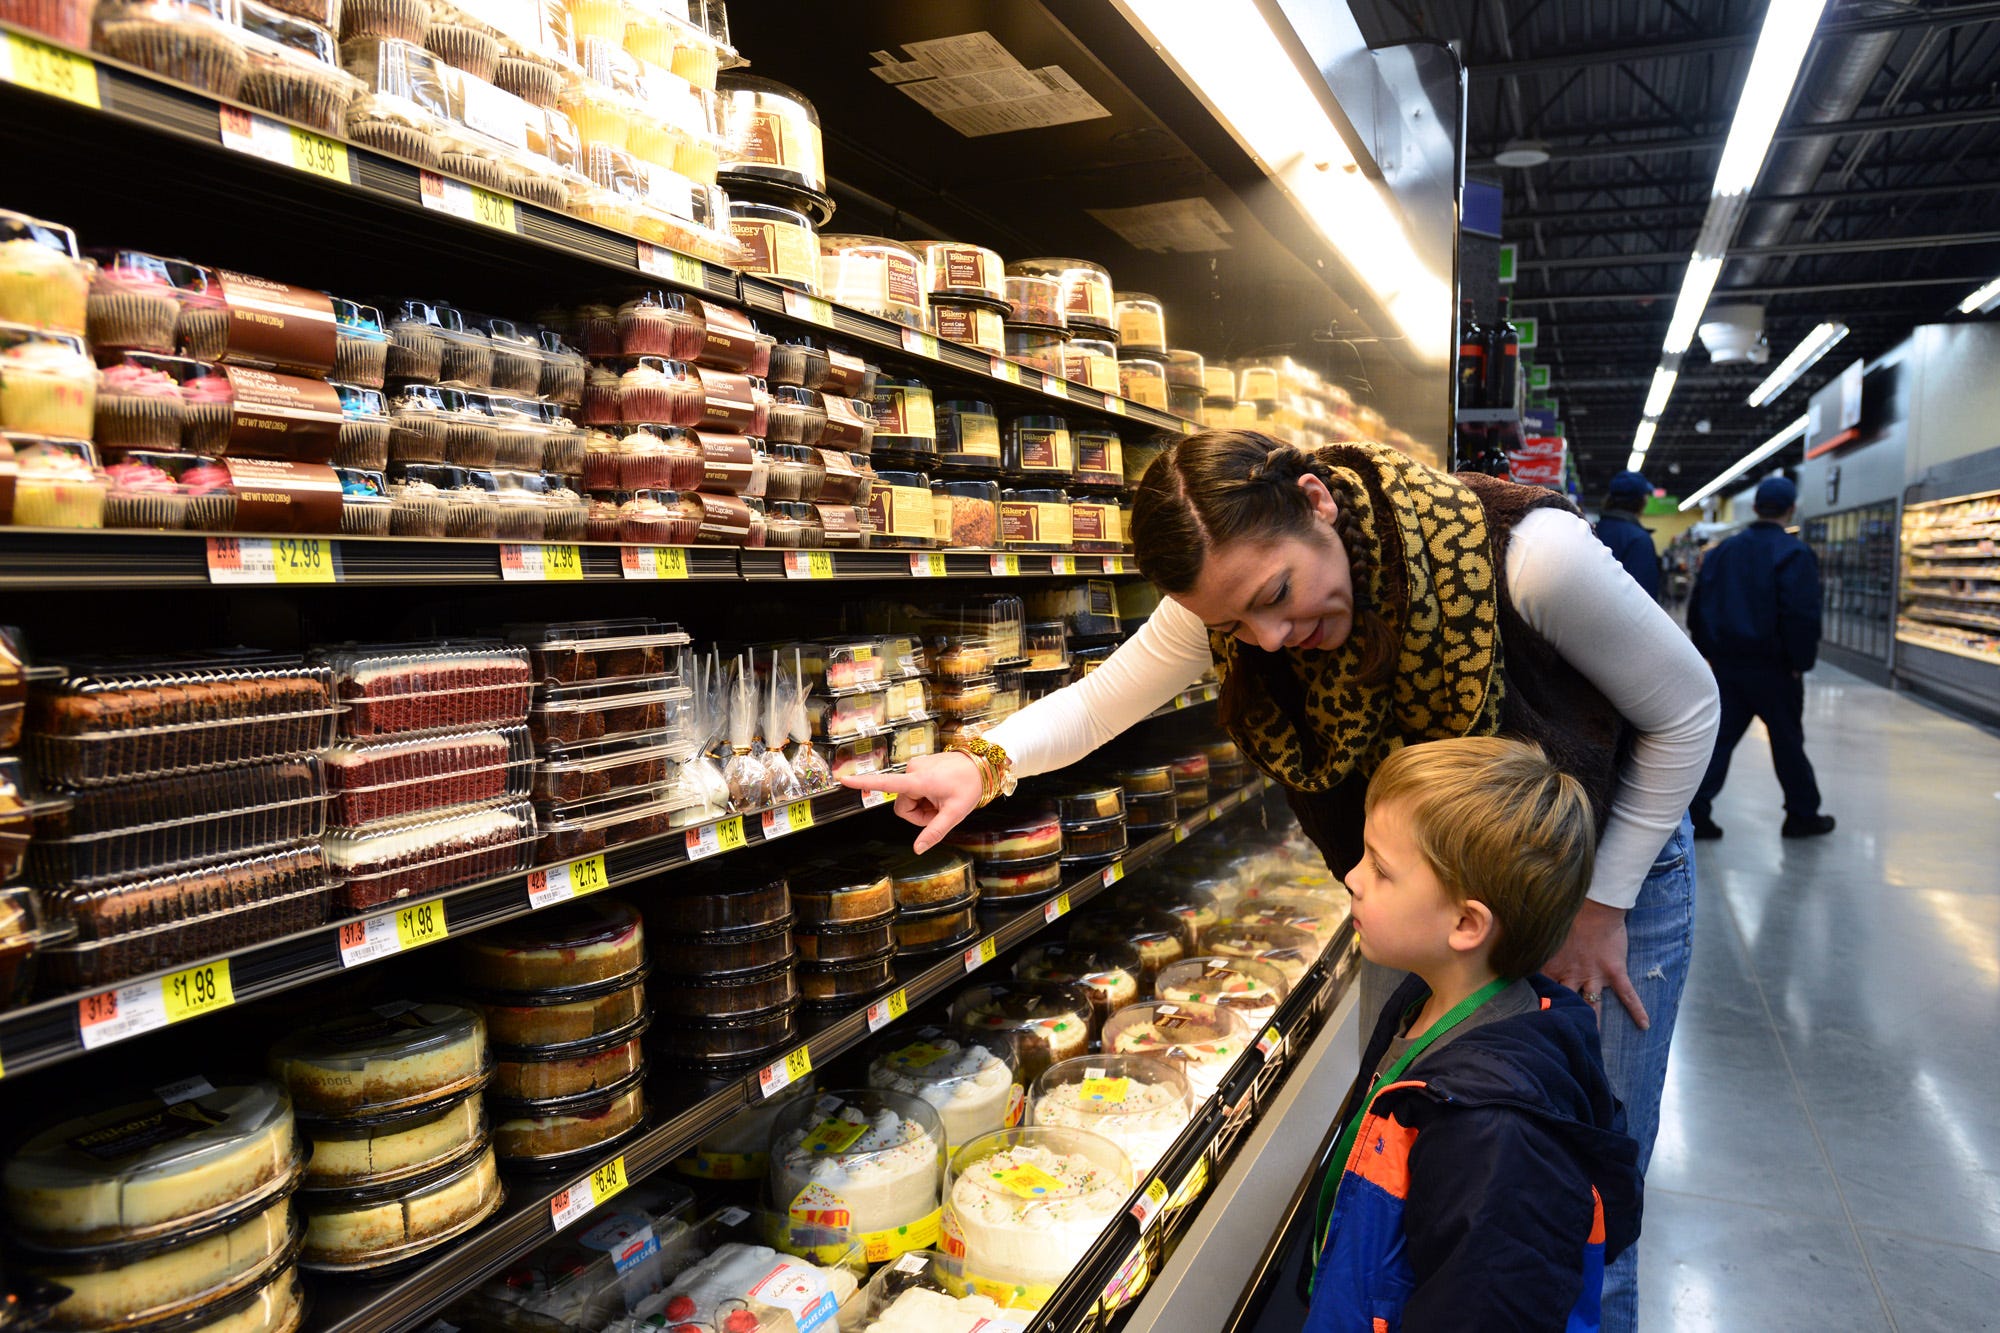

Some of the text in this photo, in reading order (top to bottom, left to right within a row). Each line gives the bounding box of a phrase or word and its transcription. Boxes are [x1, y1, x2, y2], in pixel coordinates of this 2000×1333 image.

[299, 134, 335, 174] $3.98
[479, 191, 505, 226] $3.78
[950, 253, 975, 262] Bakery
[243, 275, 289, 293] Cupcakes
[941, 310, 967, 319] Bakery
[229, 367, 277, 383] Chocolate
[234, 377, 255, 388] Mini
[255, 379, 300, 396] Cupcakes
[1023, 434, 1047, 442] Bakery
[1074, 507, 1098, 517] Bakery
[280, 539, 320, 568] $2.98
[546, 545, 574, 568] $2.98
[659, 549, 681, 570] $2.98
[720, 820, 739, 844] $1.50
[574, 859, 598, 887] $2.75
[403, 905, 434, 938] $1.98
[174, 968, 216, 1007] $1.98
[595, 1161, 617, 1193] $6.48
